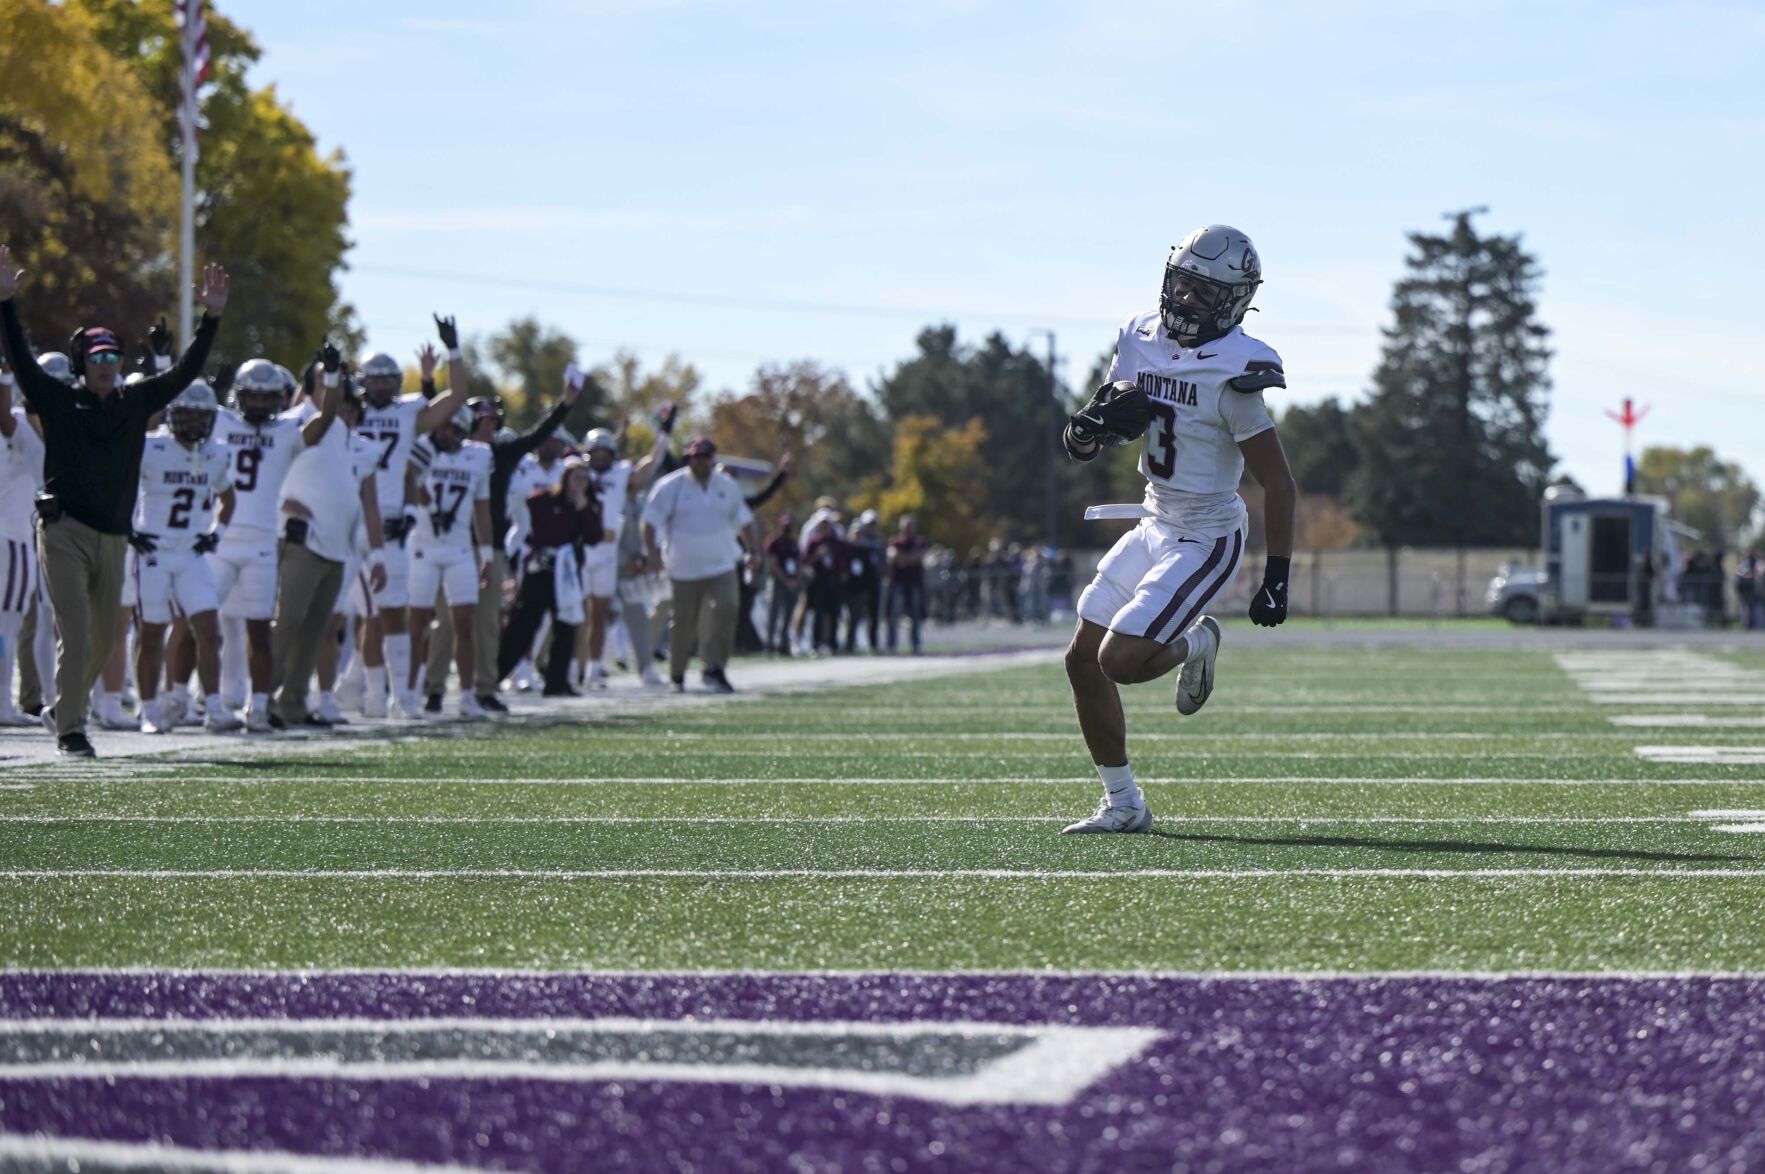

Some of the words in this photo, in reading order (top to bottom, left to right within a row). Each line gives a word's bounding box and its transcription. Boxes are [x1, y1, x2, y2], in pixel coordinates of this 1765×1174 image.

[1137, 372, 1198, 406] MONTANA
[1147, 400, 1177, 481] 3
[235, 448, 260, 492] 9
[433, 482, 469, 520] 17
